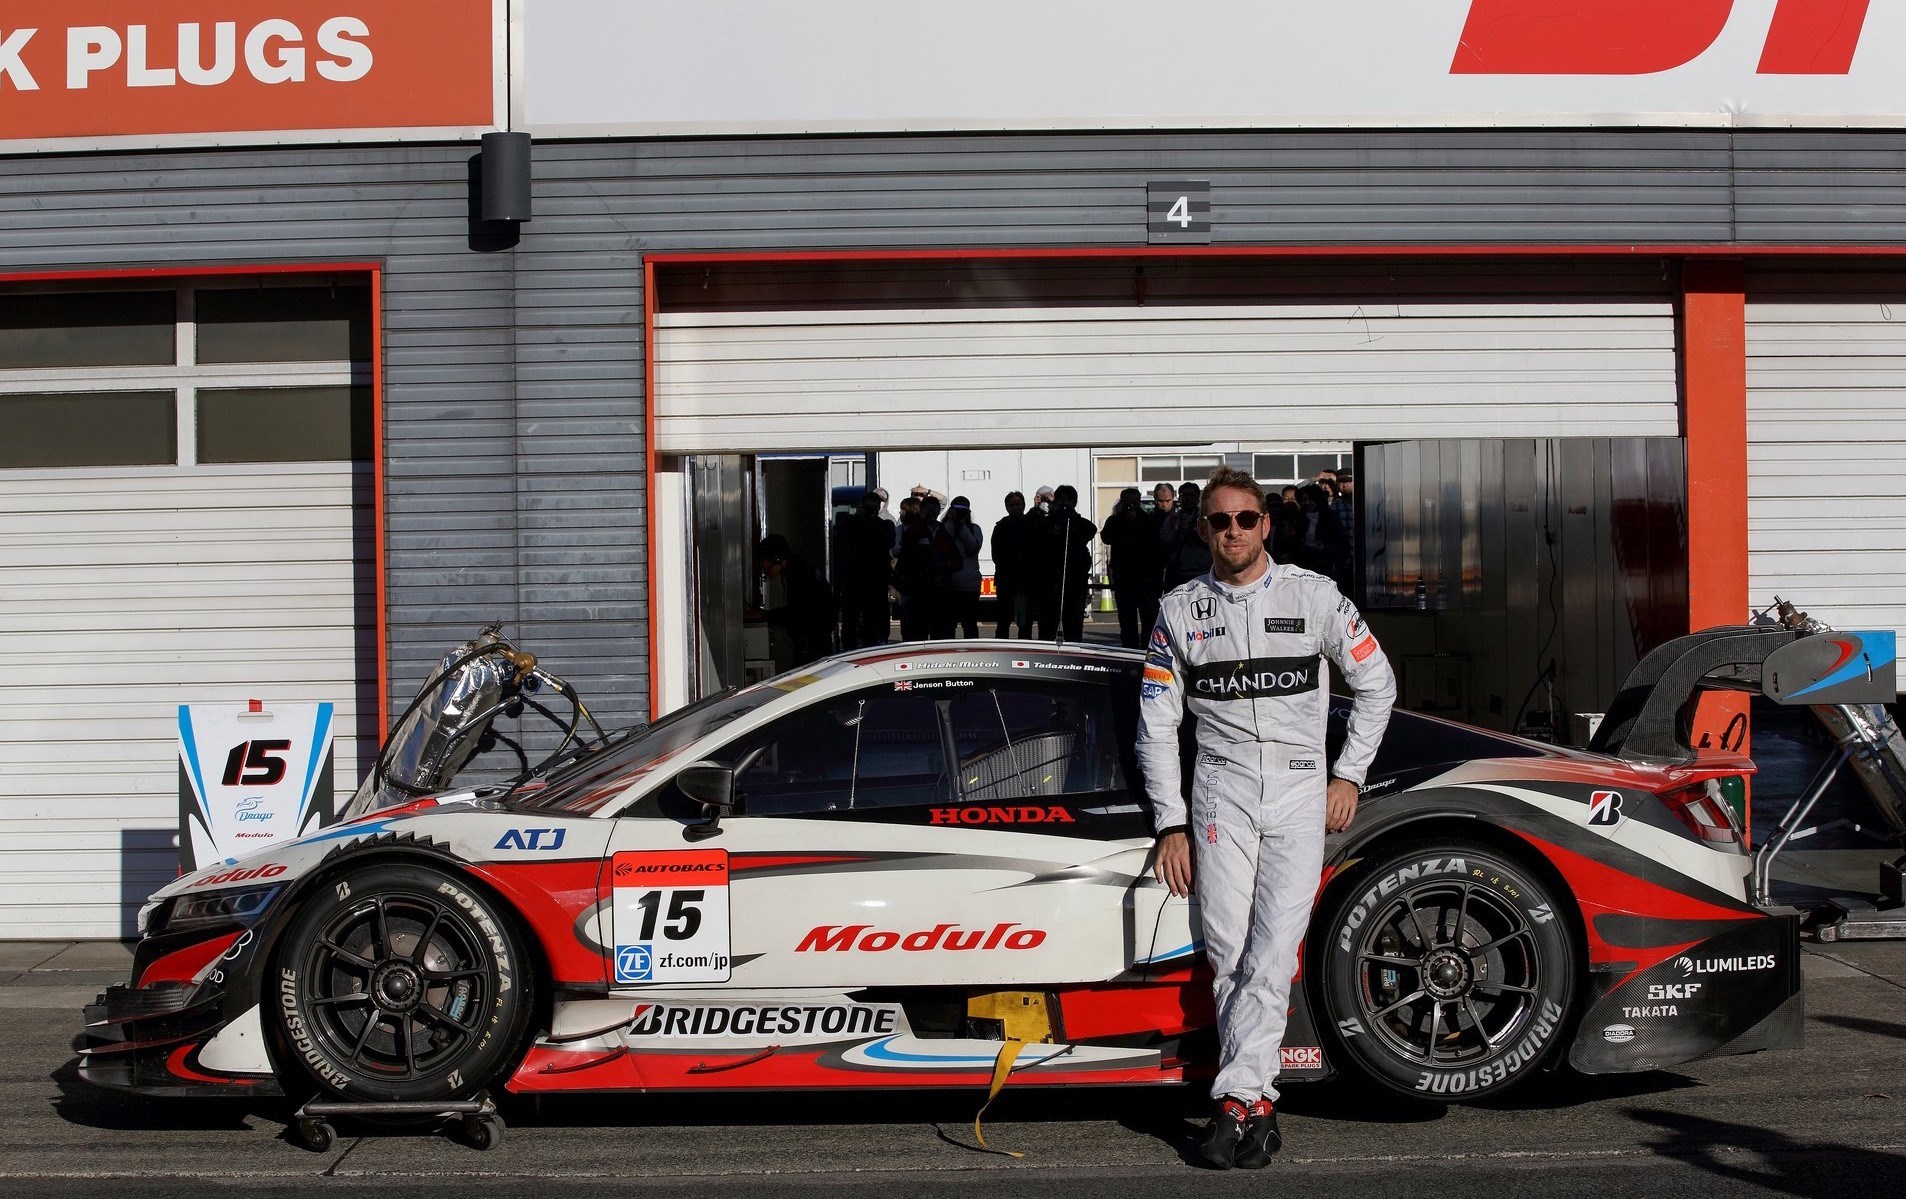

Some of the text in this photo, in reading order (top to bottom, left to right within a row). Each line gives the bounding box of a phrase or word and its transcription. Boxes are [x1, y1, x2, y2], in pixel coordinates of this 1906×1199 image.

[66, 16, 374, 89] PLUGS
[1166, 196, 1192, 228] 4
[1187, 628, 1214, 641] Mobil
[1033, 661, 1082, 670] Tadasuke
[913, 680, 974, 689] Jenson Button
[1143, 684, 1162, 697] SAP
[1196, 669, 1308, 694] CHANDON
[221, 739, 292, 786] 15
[929, 806, 1075, 824] HONDA
[493, 828, 566, 850] ATJ
[187, 863, 288, 889] odulo
[634, 863, 726, 874] AUTOBACS
[636, 889, 705, 941] 15
[1339, 858, 1468, 953] POTENZA
[437, 882, 512, 993] POTENZA
[794, 922, 1047, 952] Modulo
[659, 952, 728, 970] zf.com/jp
[1696, 954, 1776, 973] LUMILEDS
[1647, 983, 1702, 1000] SKF
[629, 1004, 896, 1035] BRIDGESTONE
[1622, 1005, 1678, 1018] TAKATA
[281, 967, 352, 1090] BRIDGESTONE
[1604, 1030, 1634, 1038] DIADORA
[1281, 1048, 1320, 1063] NGK
[1415, 997, 1563, 1093] BRIDGESTONE
